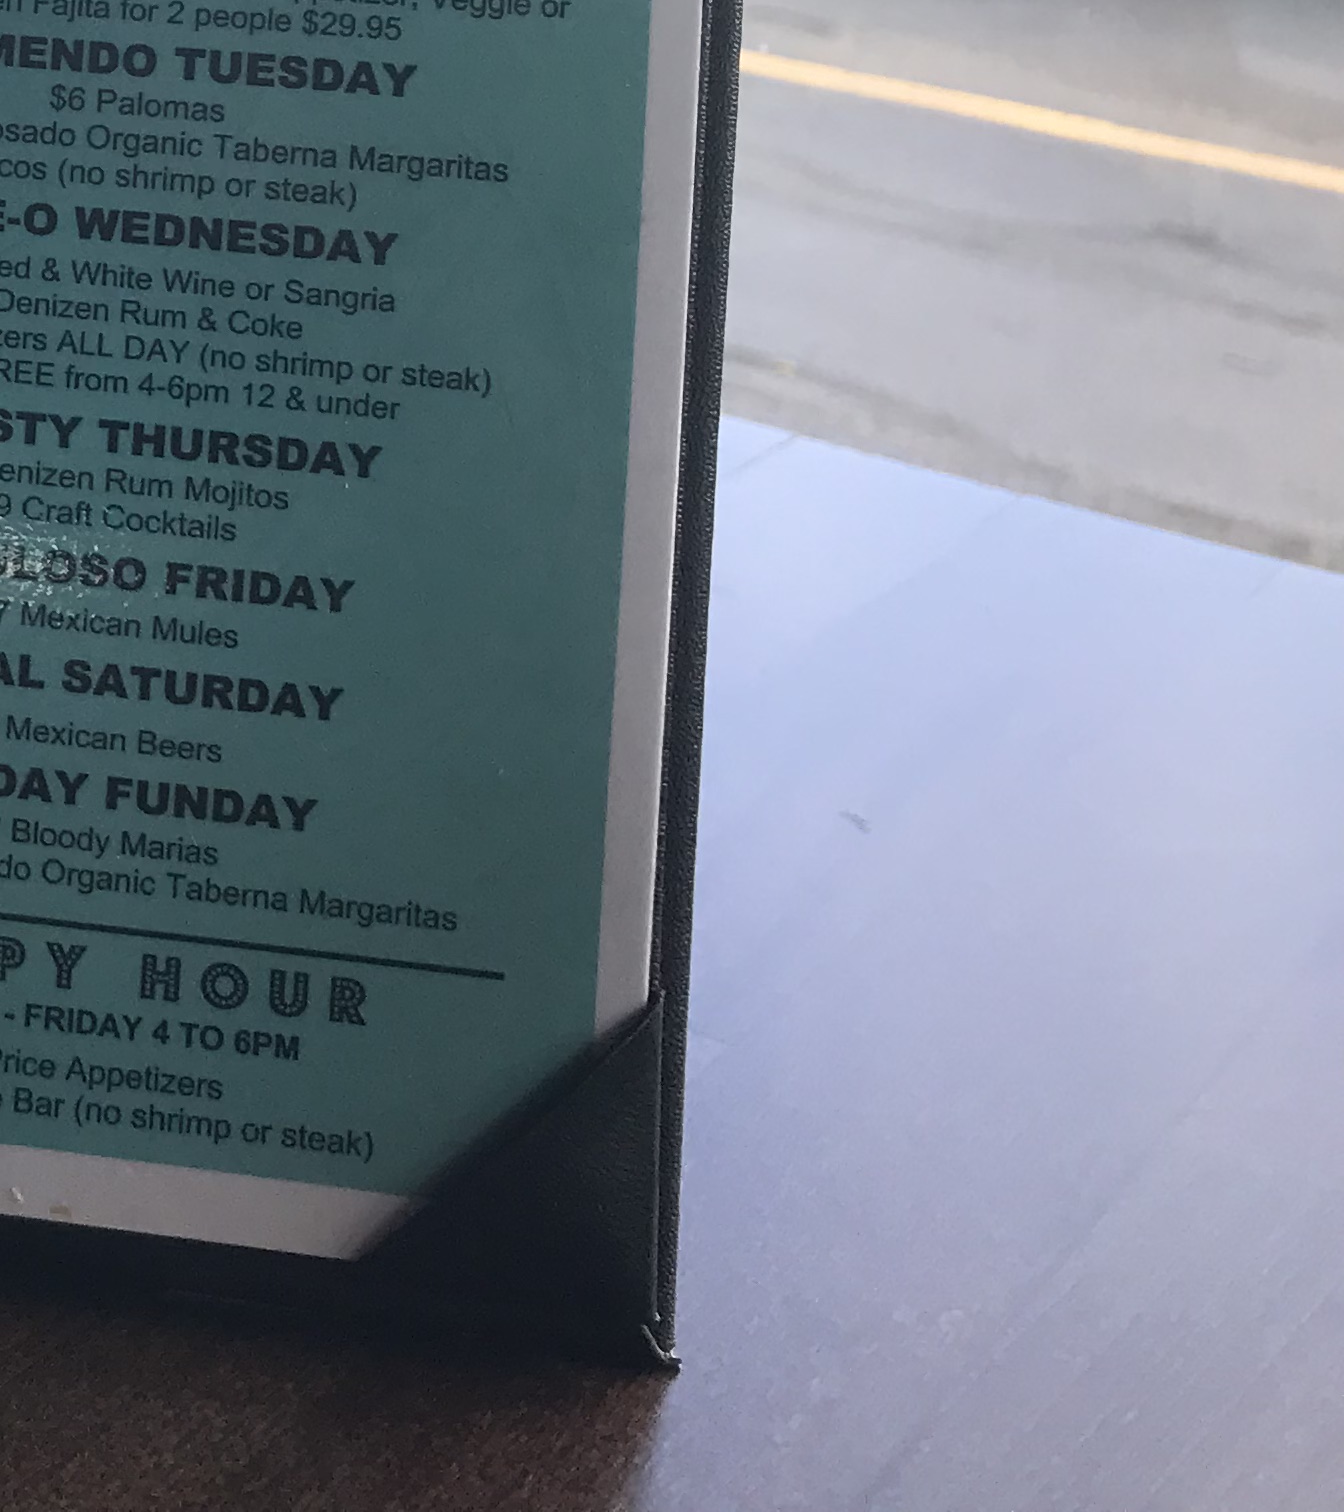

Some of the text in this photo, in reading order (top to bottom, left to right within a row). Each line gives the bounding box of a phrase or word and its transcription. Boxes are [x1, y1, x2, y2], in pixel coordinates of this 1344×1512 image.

[166, 0, 184, 24] 2
[194, 7, 291, 35] people
[302, 9, 401, 40] $29.95
[540, 0, 571, 18] or
[174, 46, 417, 97] TUESDAY
[49, 83, 224, 122] $6 Palomas
[86, 124, 202, 157] Organic
[212, 134, 336, 167] Taberna
[349, 144, 508, 182] Margaritas
[58, 158, 104, 188] (no
[115, 163, 214, 199] shrimp
[225, 177, 256, 197] or
[264, 178, 356, 212] steak)
[74, 206, 398, 265] WEDNESDAY
[41, 257, 60, 281] &
[71, 259, 152, 290] White
[162, 267, 234, 297] Wine
[245, 282, 274, 301] or
[284, 279, 394, 315] Sangria
[120, 299, 186, 329] Rum
[197, 306, 217, 331] &
[227, 309, 302, 339] Coke
[56, 329, 112, 357] ALL
[123, 335, 189, 363] DAY
[199, 342, 245, 373] (no
[255, 349, 353, 384] shrimp
[362, 364, 392, 383] or
[401, 363, 491, 398] steak)
[64, 364, 128, 393] from
[137, 372, 228, 406] 4-6pm
[243, 382, 274, 408] 12
[285, 385, 306, 411] &
[316, 392, 399, 419] under
[97, 418, 382, 478] THURSDAY
[105, 467, 172, 498] Rum
[184, 476, 288, 509] Mojitos
[21, 496, 93, 527] Craft
[101, 504, 237, 542] Cocktails
[163, 561, 354, 612] FRIDAY
[20, 601, 141, 638] Mexican
[152, 615, 238, 648] Mules
[61, 659, 344, 720] SATURDAY
[5, 714, 125, 751] Mexican
[137, 729, 221, 762] Beers
[105, 776, 318, 831] FUNDAY
[11, 818, 109, 856] Bloody
[120, 830, 218, 865] Marias
[40, 857, 156, 902] Organic
[166, 872, 289, 911] Taberna
[298, 888, 459, 937] Margaritas
[139, 953, 366, 1025] HOUR
[23, 1002, 142, 1041] FRIDAY
[151, 1019, 169, 1044] 4
[179, 1022, 223, 1050] TO
[234, 1029, 299, 1060] 6PM
[65, 1056, 222, 1100] Appetizers
[13, 1087, 64, 1118] Bar
[74, 1095, 121, 1125] (no
[130, 1104, 230, 1143] shrimp
[241, 1123, 272, 1144] or
[281, 1125, 373, 1162] steak)
